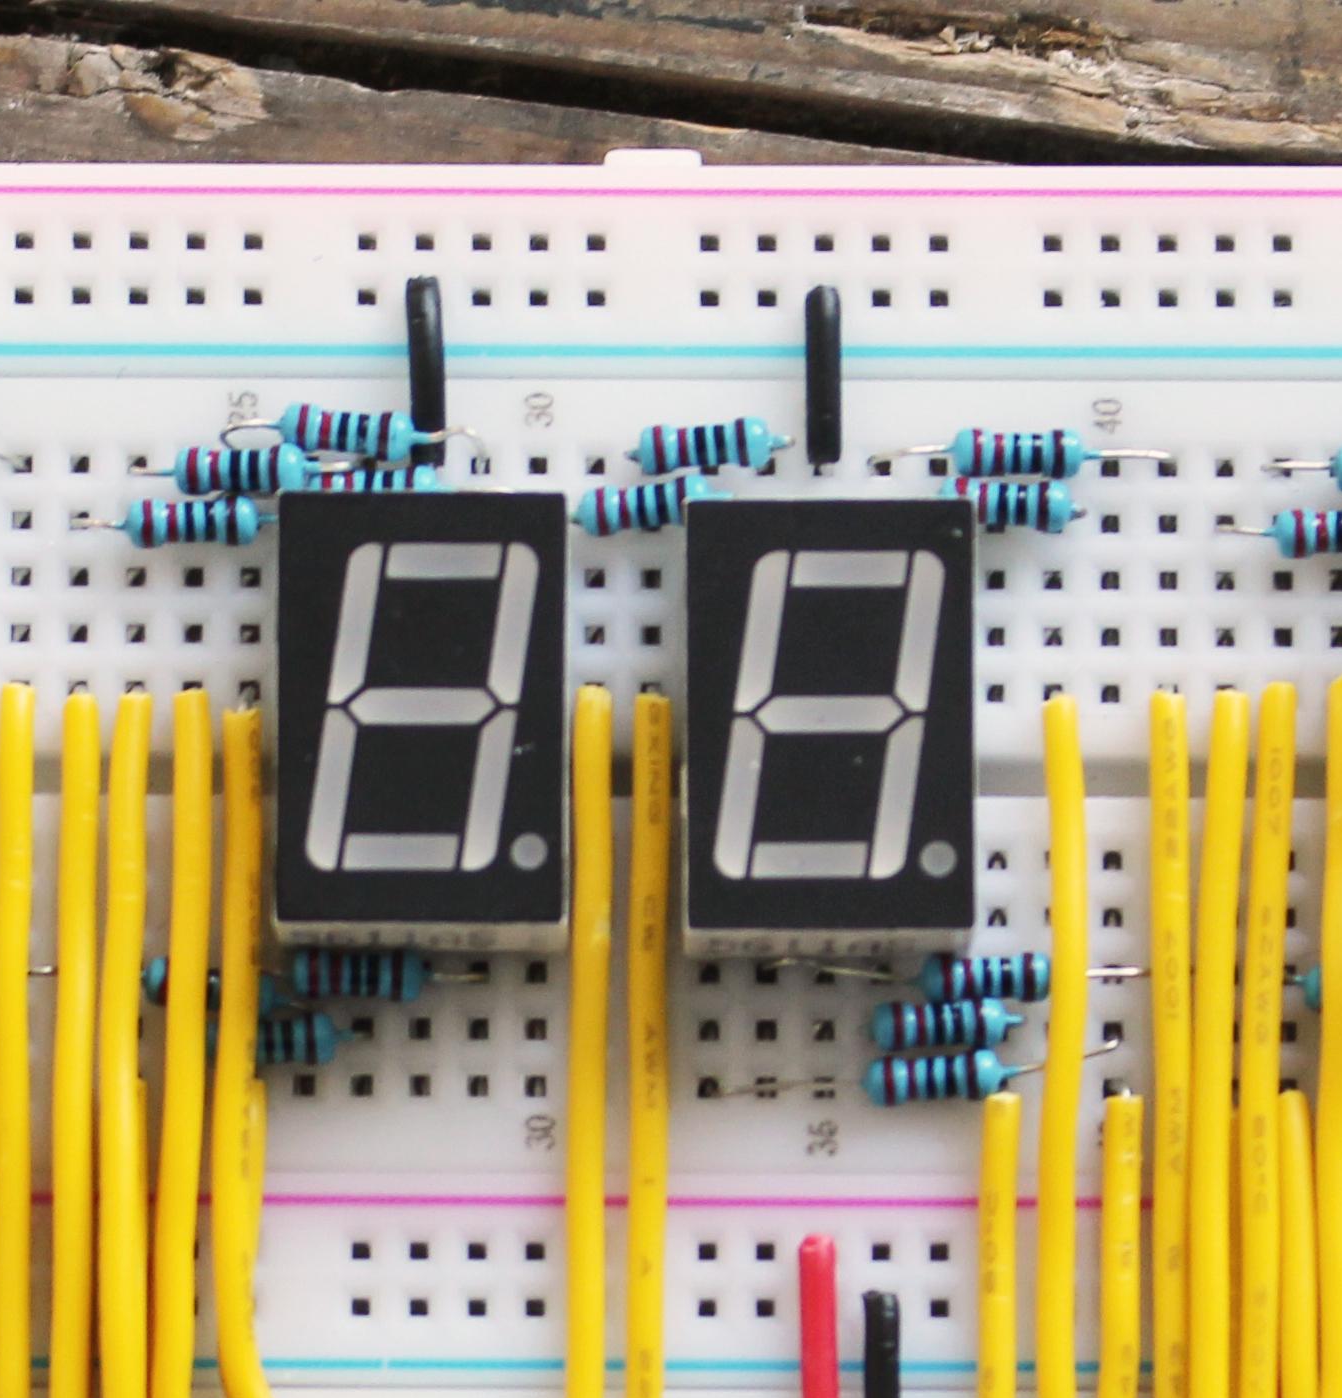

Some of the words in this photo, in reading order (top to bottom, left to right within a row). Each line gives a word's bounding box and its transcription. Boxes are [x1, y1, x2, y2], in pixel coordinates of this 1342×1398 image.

[523, 391, 554, 428] 30
[1091, 398, 1122, 435] 40
[525, 1114, 558, 1151] 30
[806, 1117, 840, 1156] 35
